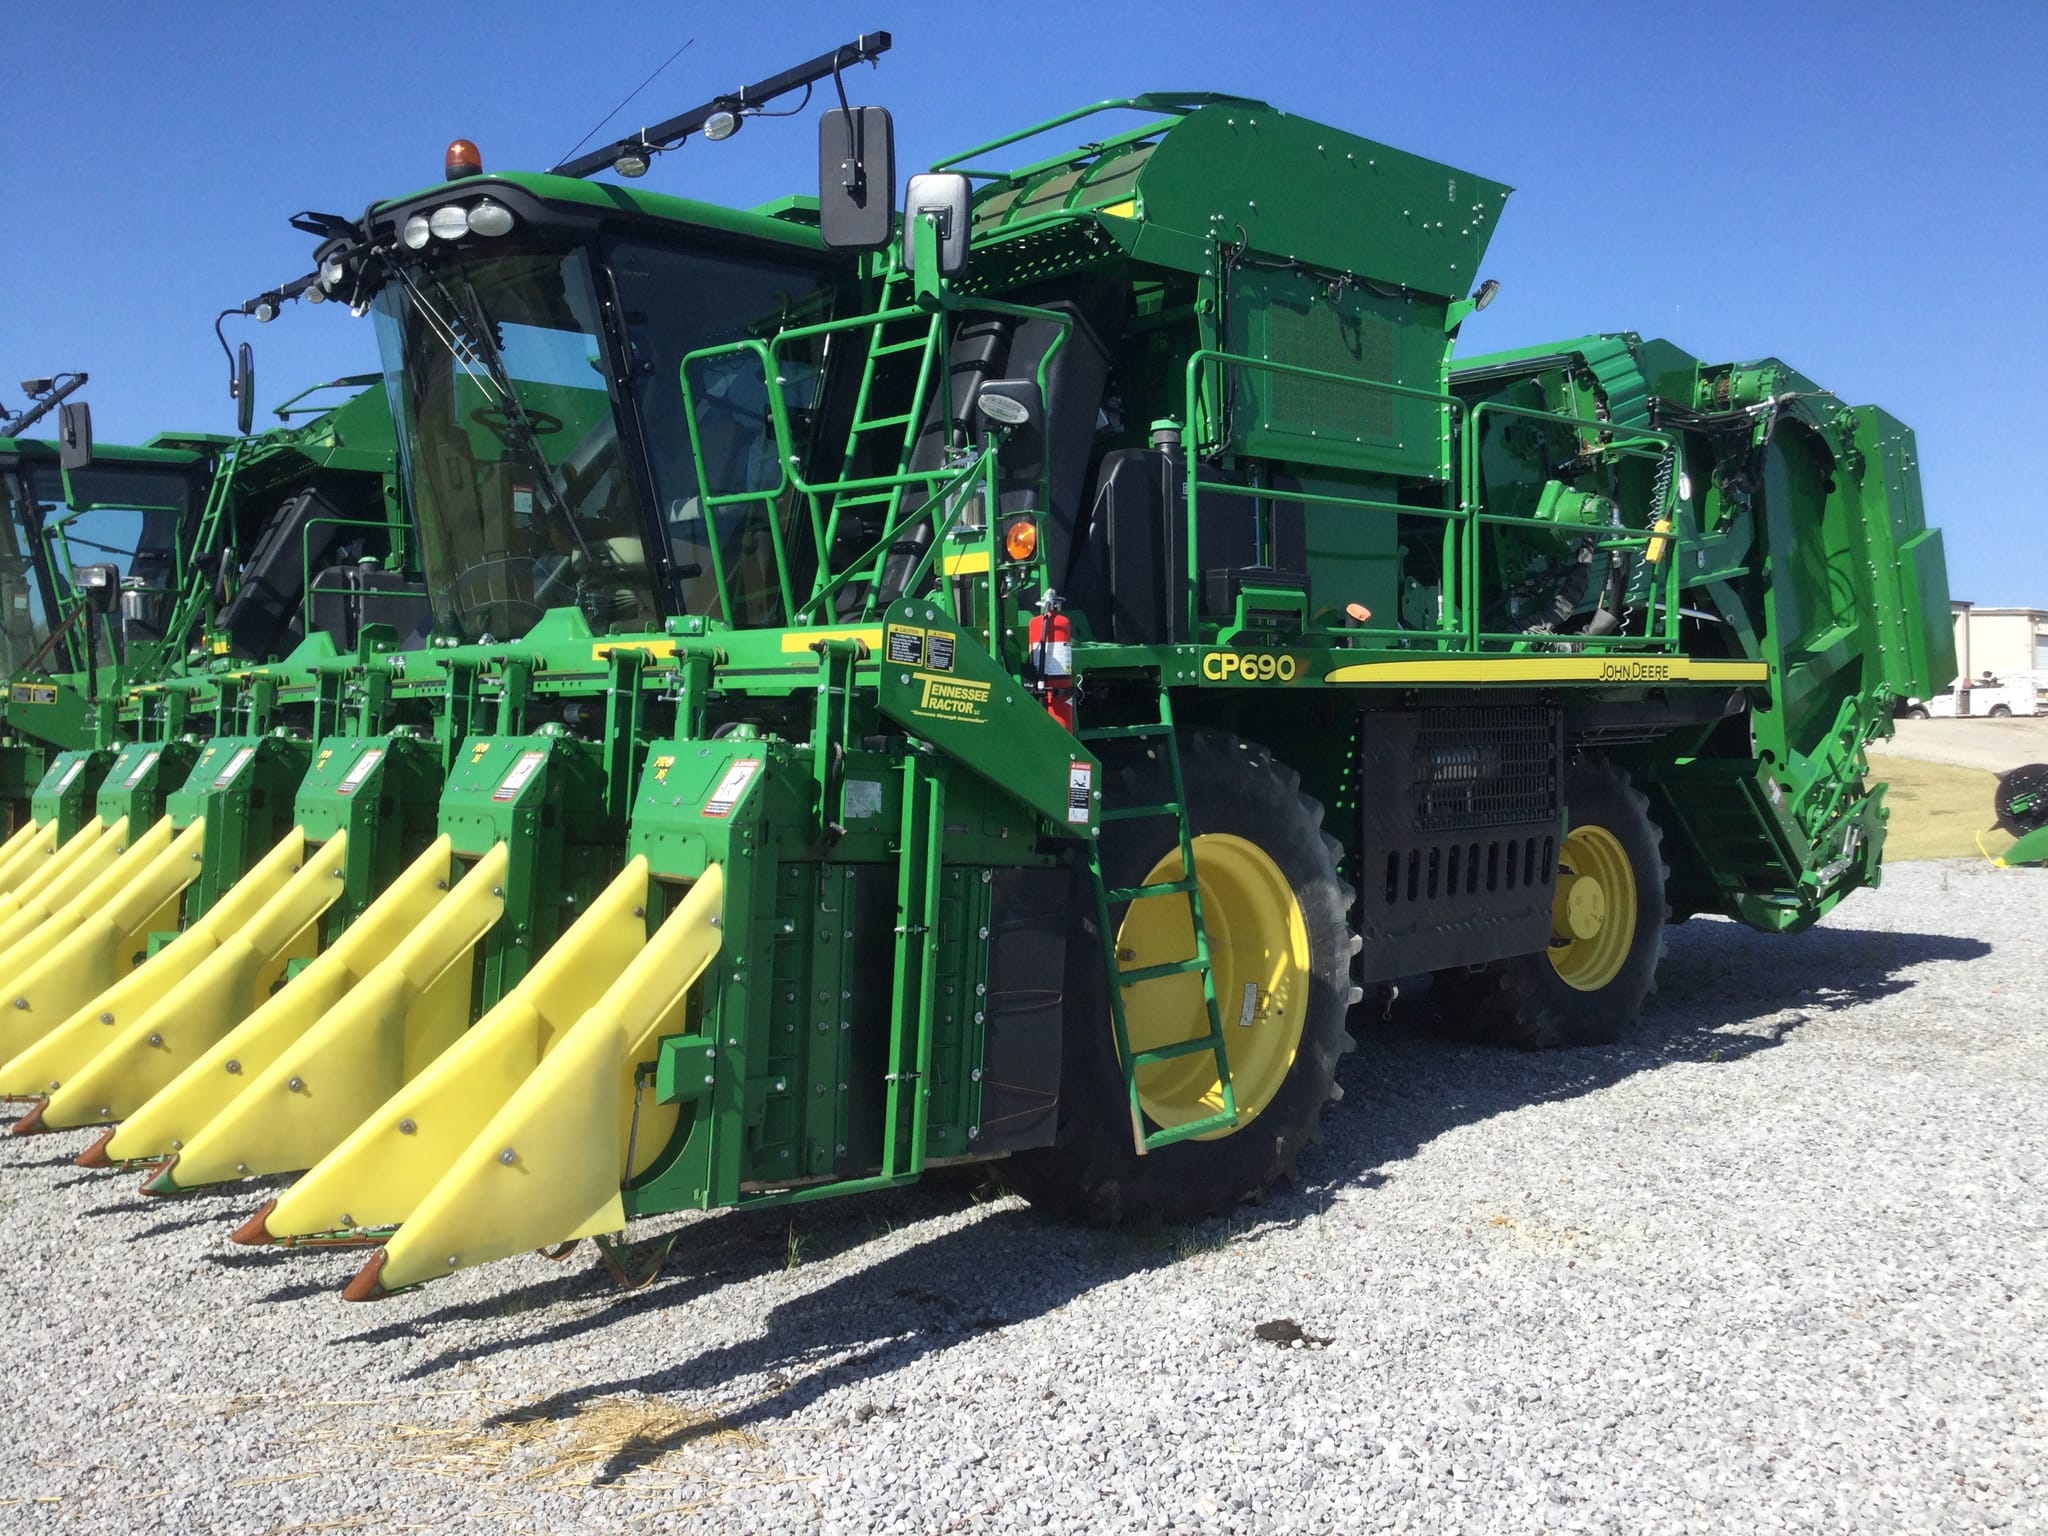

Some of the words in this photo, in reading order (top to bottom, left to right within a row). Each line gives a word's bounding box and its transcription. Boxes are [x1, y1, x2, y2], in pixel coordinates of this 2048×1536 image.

[1203, 652, 1296, 681] CP690
[1600, 662, 1630, 679] JOHN
[1632, 662, 1669, 679] DEERE
[912, 672, 991, 705] TENNESSEE
